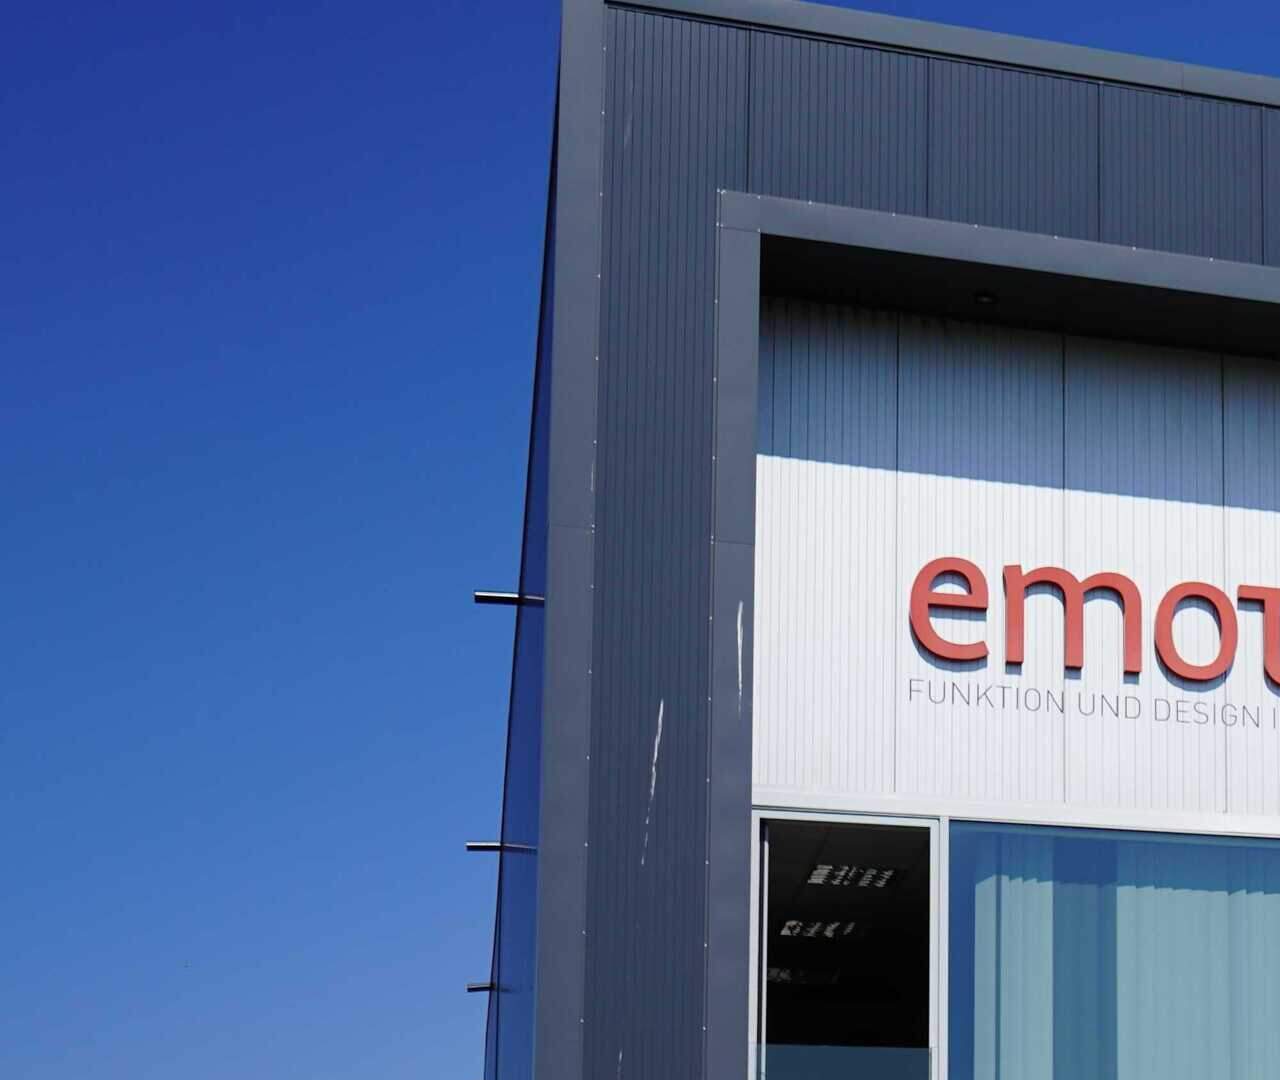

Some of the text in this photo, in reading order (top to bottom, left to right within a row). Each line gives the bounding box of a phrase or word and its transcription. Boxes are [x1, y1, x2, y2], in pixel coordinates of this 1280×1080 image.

[908, 678, 1065, 714] FUNKTION
[1078, 692, 1142, 719] UND
[1154, 698, 1261, 729] DESIGN
